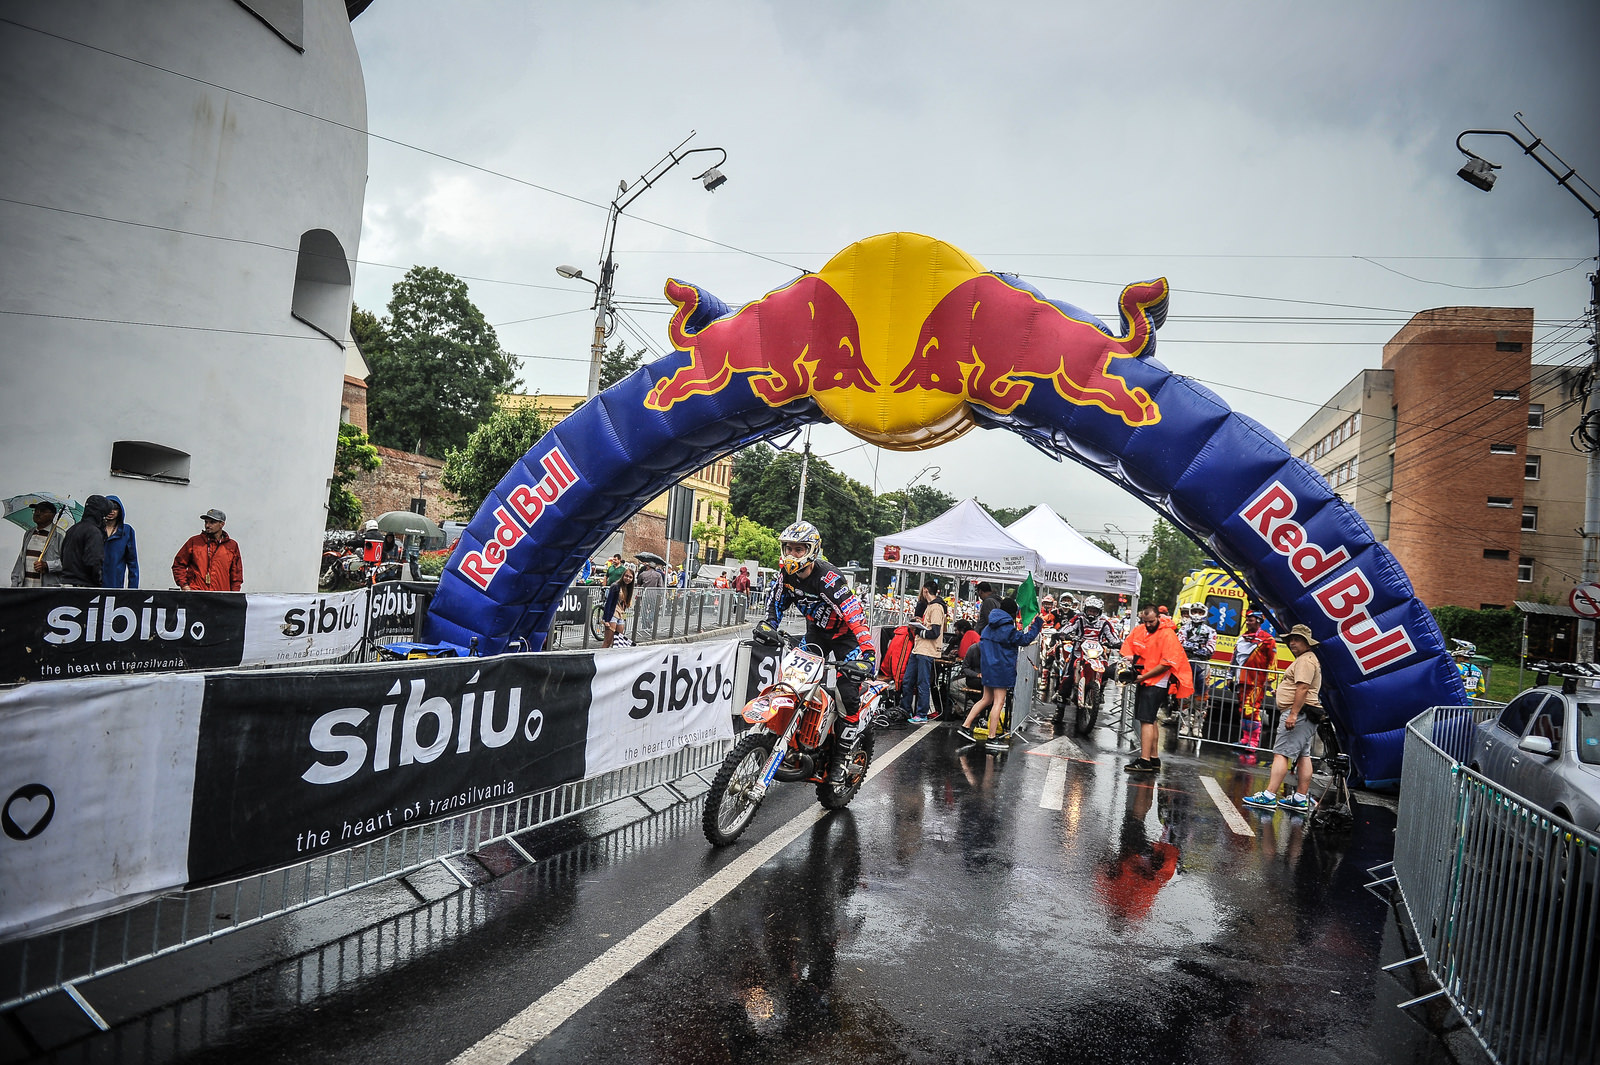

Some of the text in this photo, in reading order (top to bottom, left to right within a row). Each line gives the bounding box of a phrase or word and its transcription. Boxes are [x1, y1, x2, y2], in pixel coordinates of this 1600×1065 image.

[459, 447, 579, 590] Red Bull
[902, 554, 1001, 572] RED BULL ROMANIACS
[1240, 481, 1416, 674] Red Bull
[41, 657, 185, 676] the heart of transilvania
[790, 655, 814, 673] 376
[624, 726, 717, 760] the heart of transilvania
[297, 778, 515, 852] the heart of transilvania
